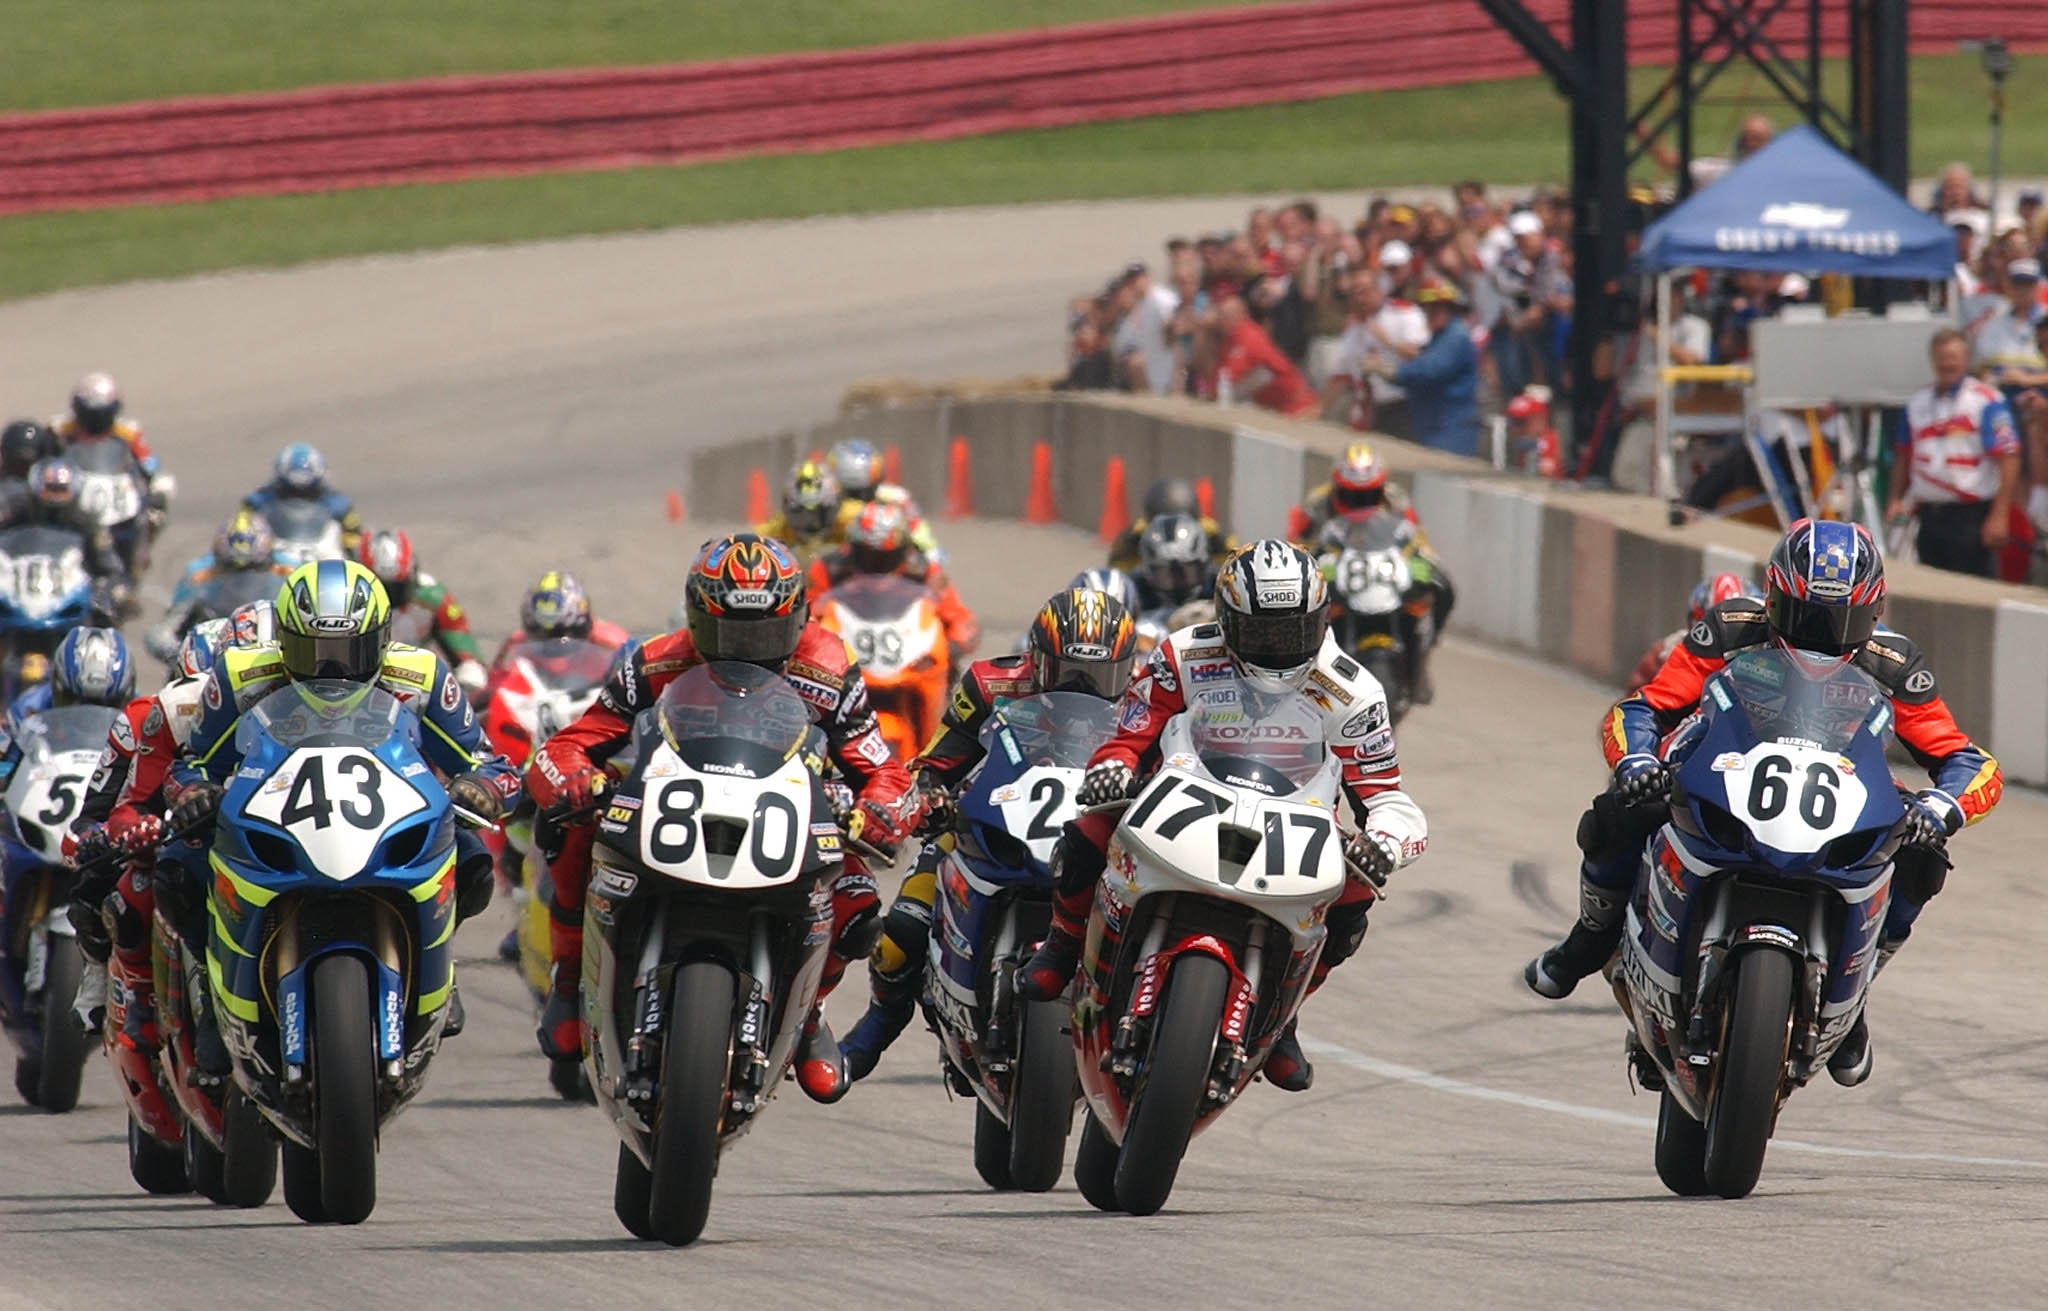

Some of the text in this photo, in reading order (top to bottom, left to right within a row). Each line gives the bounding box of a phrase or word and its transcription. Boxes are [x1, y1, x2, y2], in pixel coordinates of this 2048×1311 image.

[734, 594, 768, 605] SHOEI
[1263, 592, 1296, 603] SHOEI
[316, 620, 351, 630] HJC
[855, 628, 903, 667] 99
[1207, 726, 1309, 739] HONDA
[1777, 736, 1822, 750] SUZUKI
[281, 755, 385, 830] 43
[703, 763, 757, 778] HONDA
[1225, 775, 1275, 794] HONDA
[1747, 755, 1840, 830] 66
[39, 774, 85, 826] 5
[1026, 777, 1066, 840] 2
[1128, 775, 1234, 841] 17
[1264, 811, 1331, 878] 17
[285, 992, 301, 1055] DUNLOP
[386, 991, 401, 1054] DUNLOP
[740, 981, 762, 1043] DUNLOP
